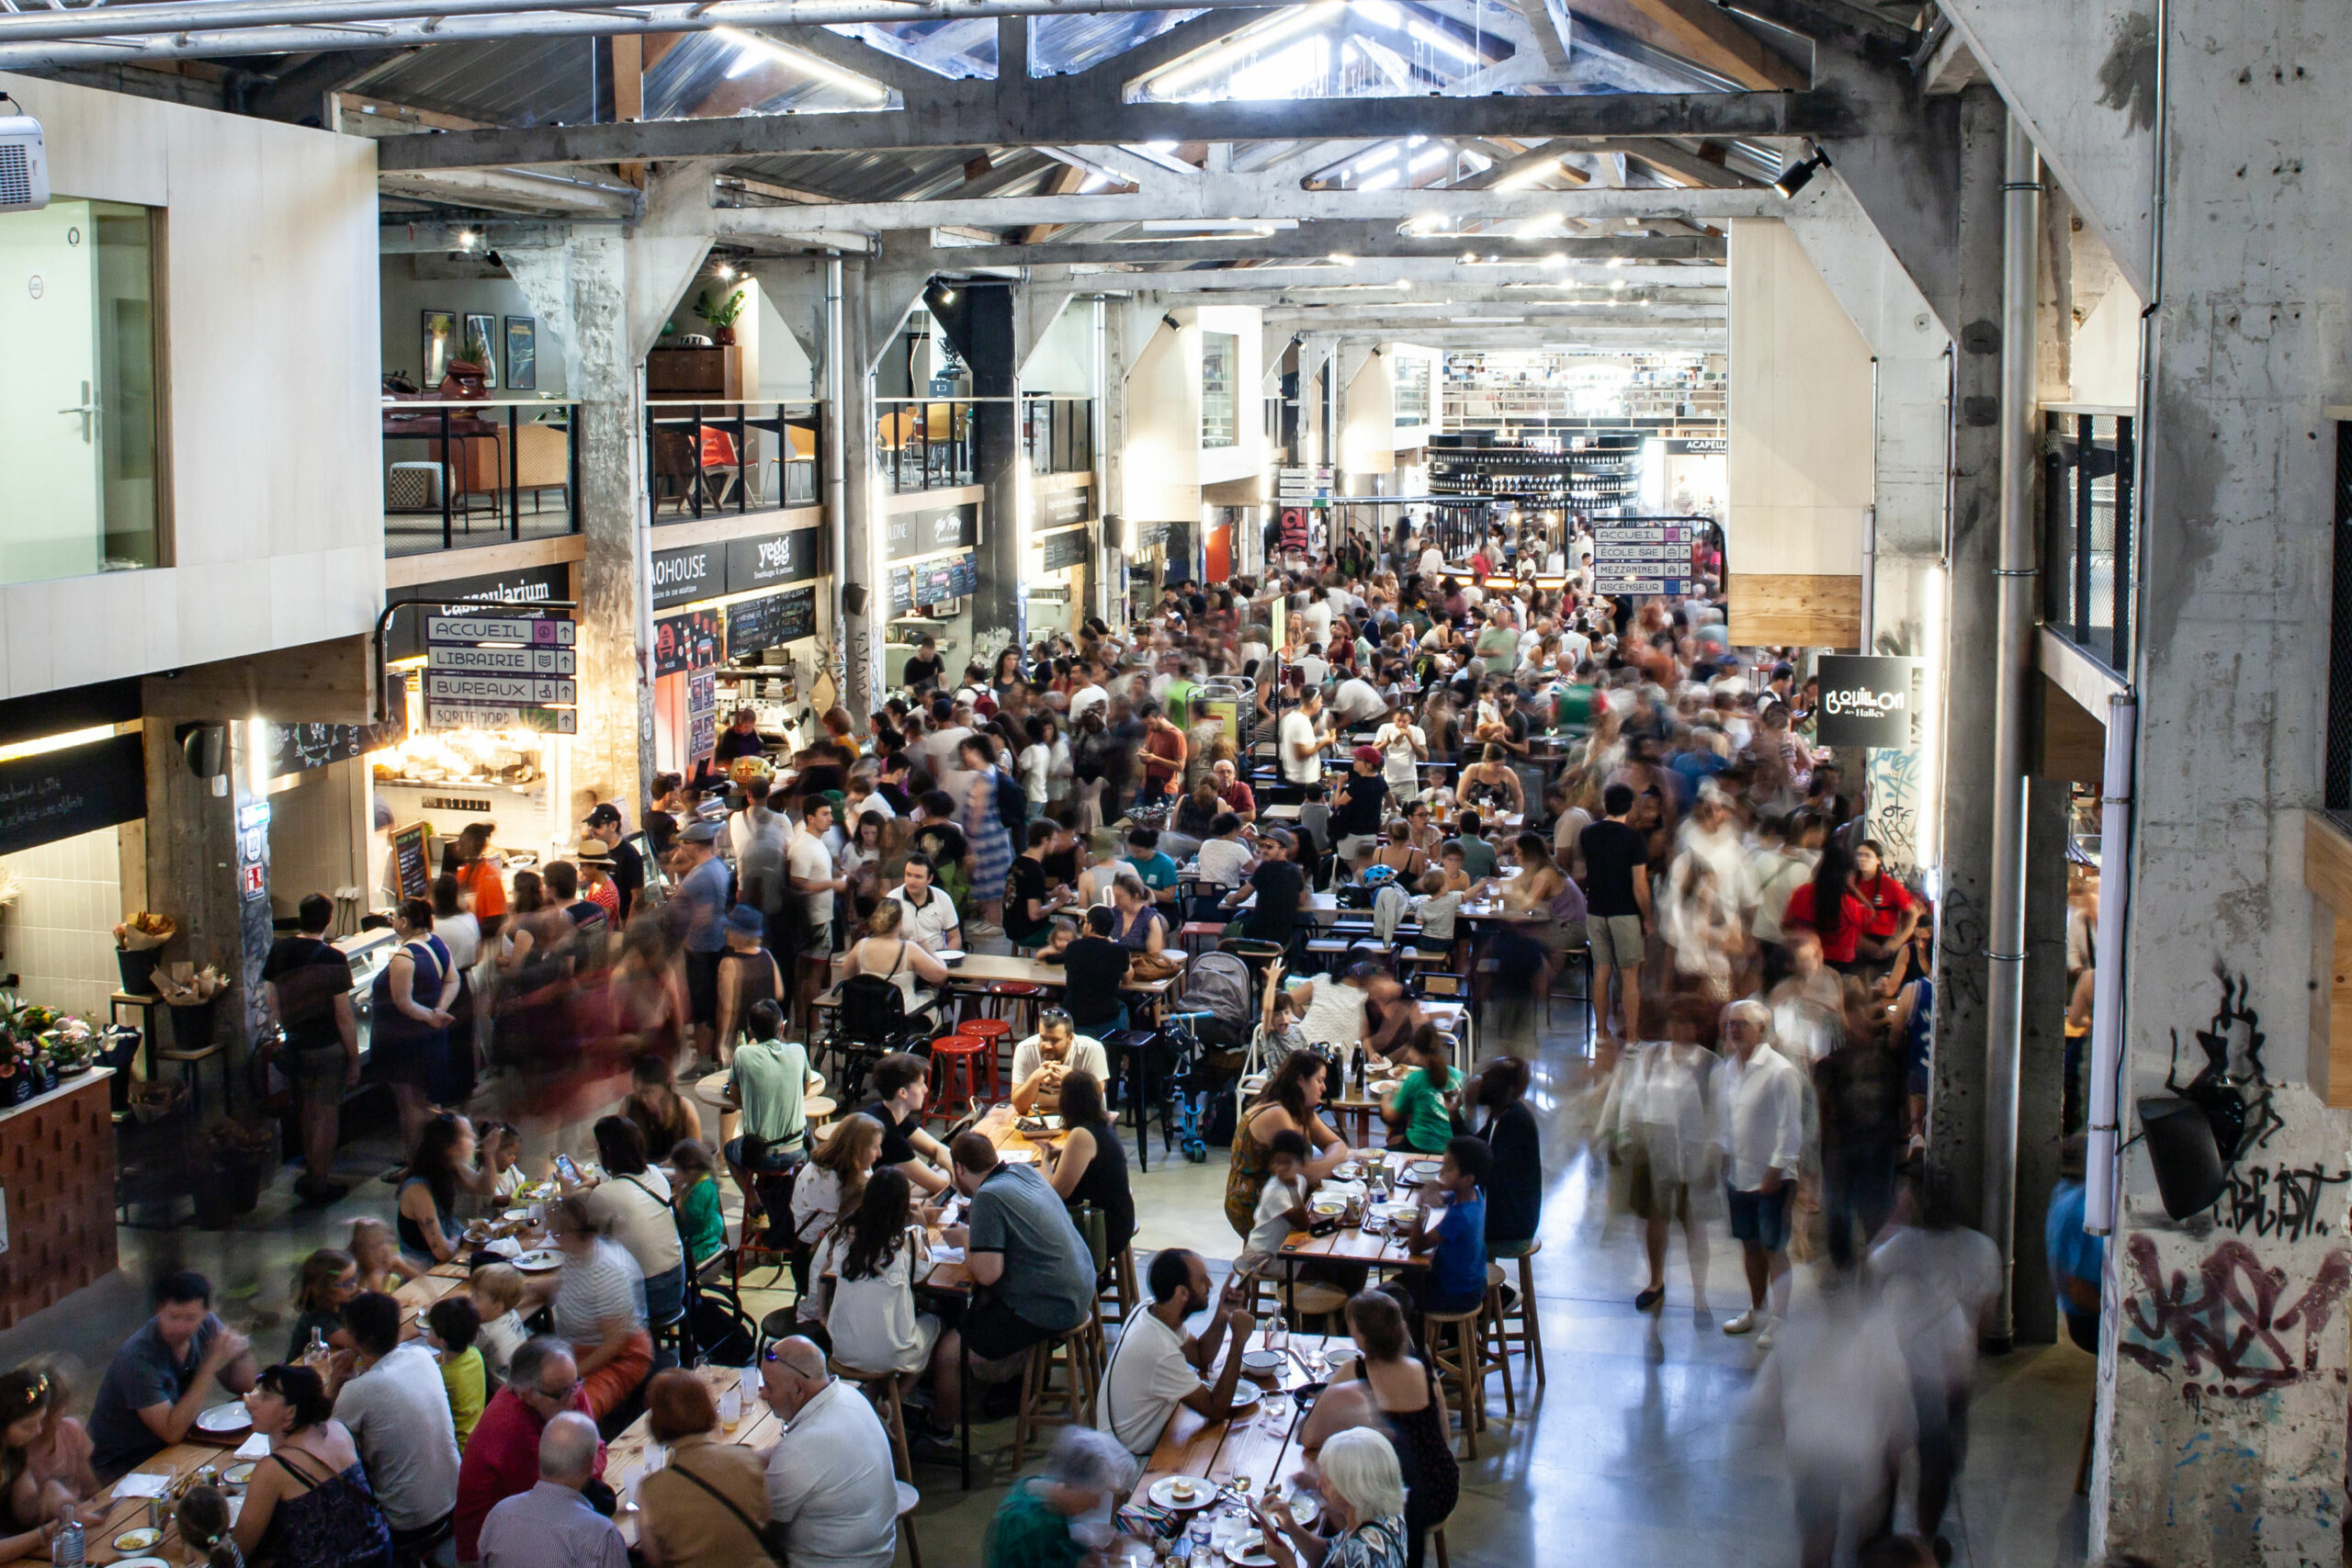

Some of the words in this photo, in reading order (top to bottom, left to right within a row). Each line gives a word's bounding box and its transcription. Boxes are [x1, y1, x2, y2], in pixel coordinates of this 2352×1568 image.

[1600, 531, 1659, 539] ACCUEIL
[758, 536, 790, 570] yegg
[1600, 546, 1634, 557] ÉCOLE
[1638, 548, 1659, 557] SAE
[1600, 565, 1659, 574] MEZZANINES
[1600, 582, 1659, 592] ASCENSEUR
[435, 622, 525, 638] ACCUEIL
[436, 651, 526, 667] LIBRAIRIE
[436, 681, 526, 696] BUREAUX
[1856, 708, 1885, 717] Halles
